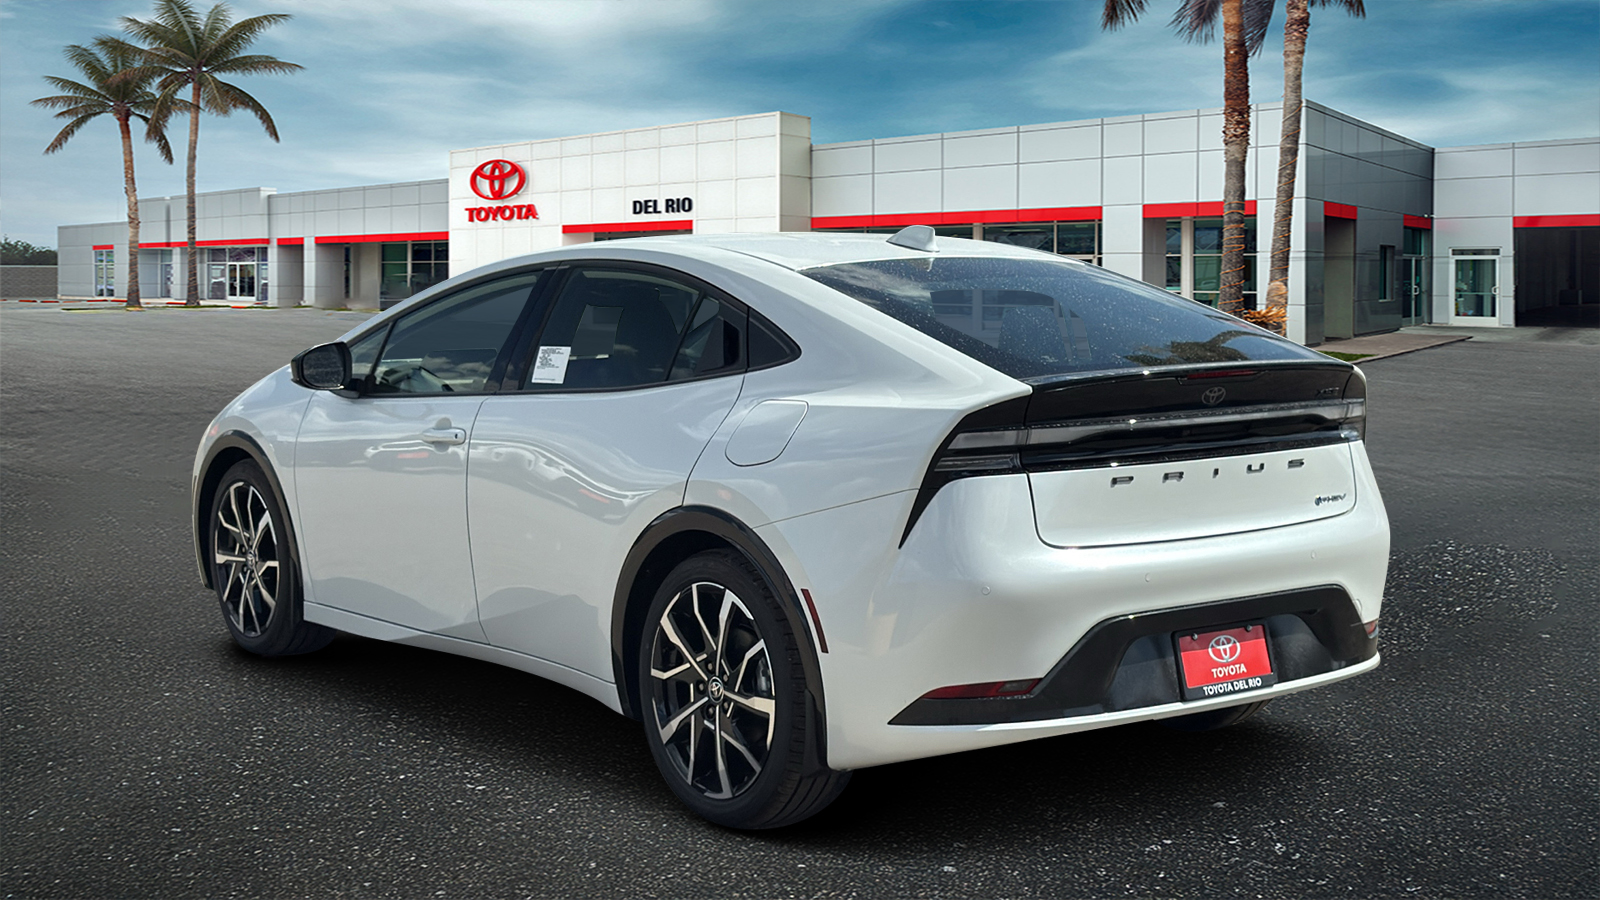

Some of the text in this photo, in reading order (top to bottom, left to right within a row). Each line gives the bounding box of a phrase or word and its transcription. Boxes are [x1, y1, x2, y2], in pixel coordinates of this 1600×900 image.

[464, 203, 539, 223] TOYOTA
[632, 197, 693, 215] DEL RIO
[1110, 458, 1305, 488] PRIUS
[1211, 663, 1247, 679] TOYOTA
[1203, 677, 1262, 696] TOYOTA DEL RIO
